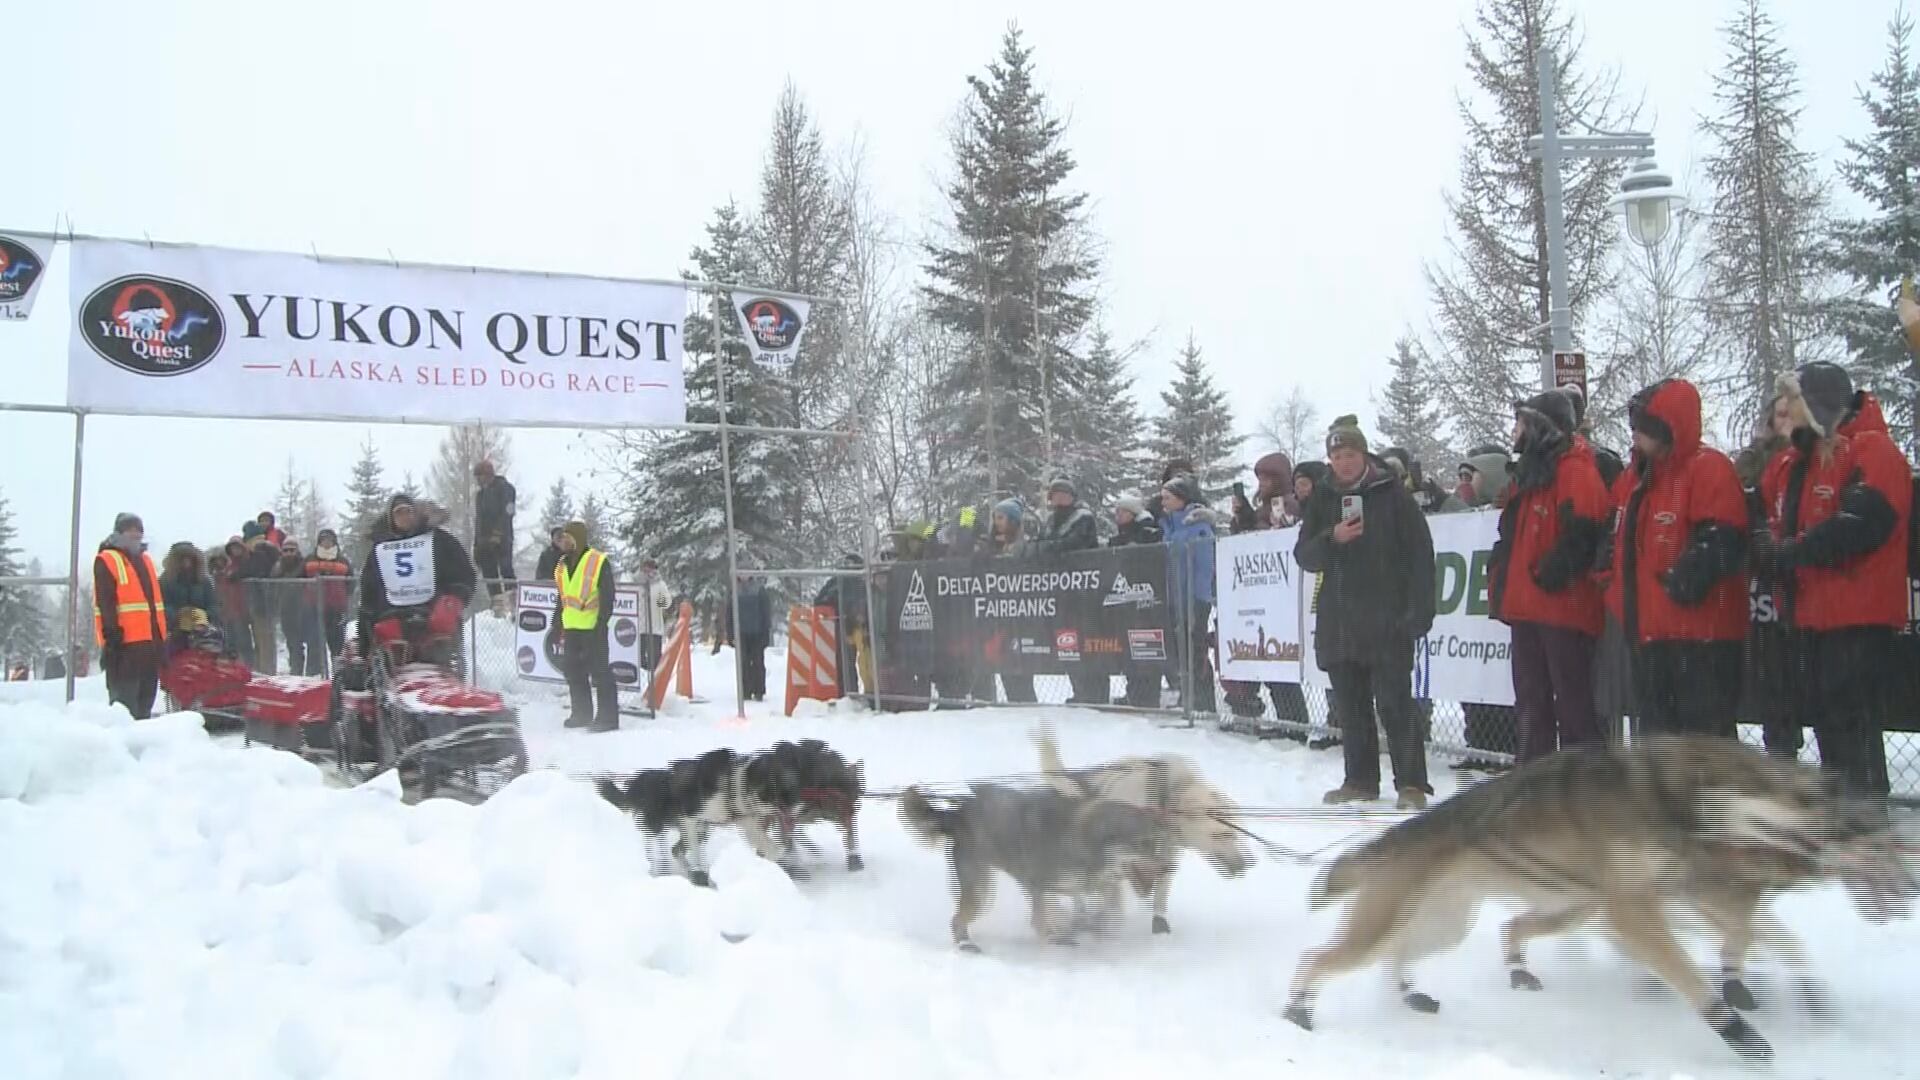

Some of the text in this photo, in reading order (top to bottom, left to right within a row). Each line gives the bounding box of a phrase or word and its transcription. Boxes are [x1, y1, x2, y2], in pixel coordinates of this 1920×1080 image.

[99, 320, 167, 342] Yukon
[229, 293, 677, 364] YUKON QUEST
[132, 340, 193, 360] Quest
[1563, 354, 1576, 366] NO
[285, 357, 637, 394] ALASKA SLED DOG RACE
[395, 552, 414, 577] 5
[938, 570, 1101, 596] DELTA POWERSPORTS
[975, 597, 1056, 618] FAIRBANKS
[1085, 639, 1122, 652] STIHL
[1429, 635, 1445, 657] of
